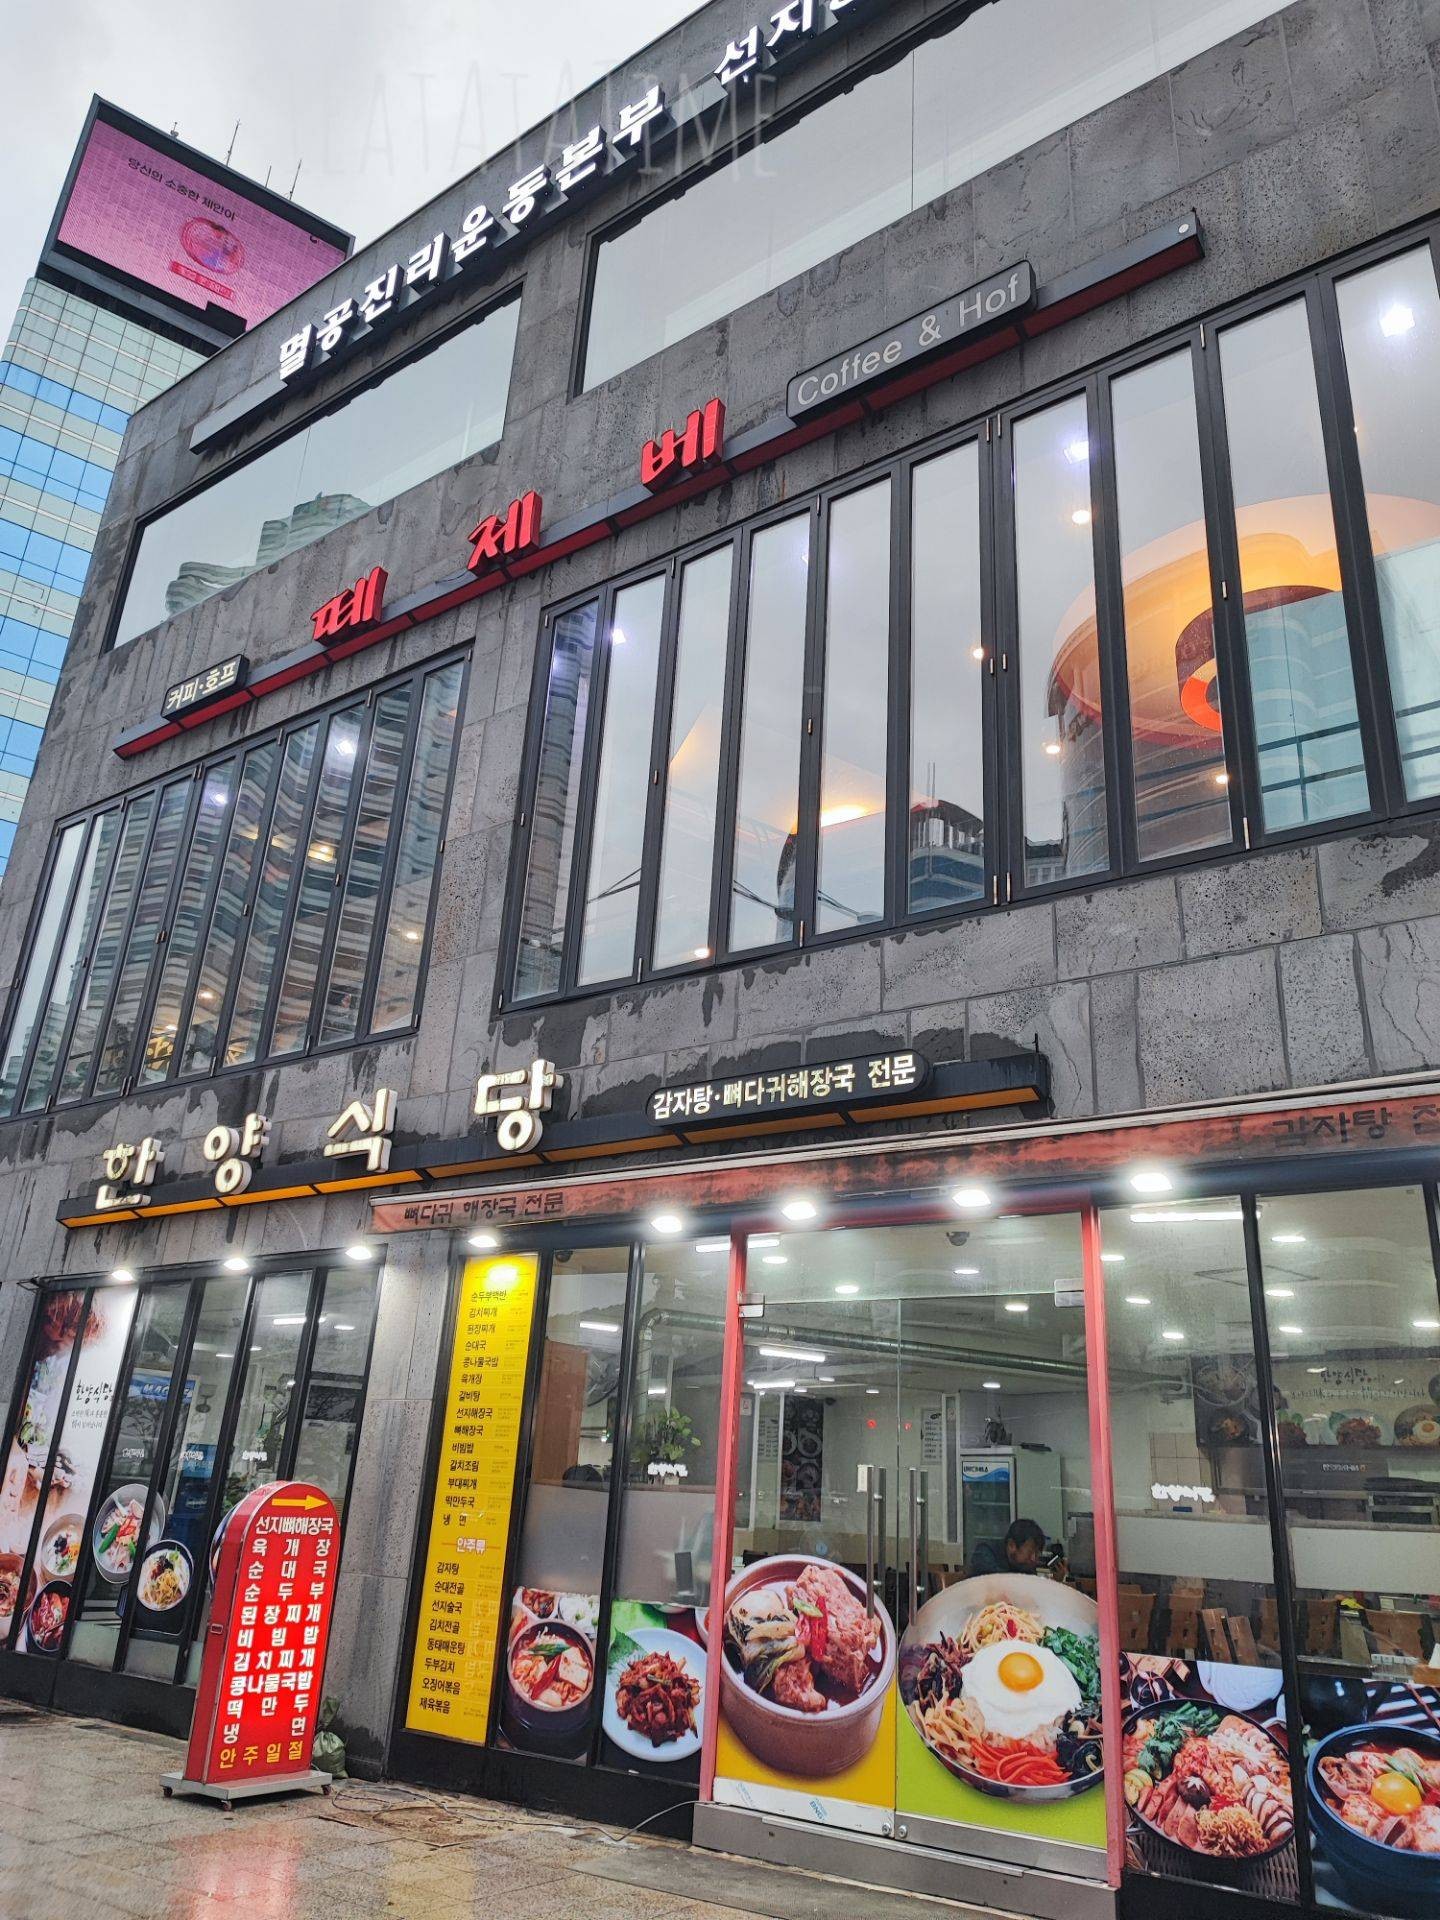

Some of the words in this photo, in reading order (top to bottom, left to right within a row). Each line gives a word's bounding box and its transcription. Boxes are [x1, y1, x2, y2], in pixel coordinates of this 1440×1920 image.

[278, 84, 666, 381] 멸공진리운동본부
[713, 0, 854, 87] 선지
[796, 340, 901, 406] Coffee
[918, 314, 943, 347] &
[959, 272, 1020, 327] Hof
[868, 1054, 917, 1088] 전문
[96, 1059, 562, 1210] 한양식당
[404, 1203, 454, 1226] 뼈다귀
[463, 1198, 517, 1221] 해장국
[524, 1191, 565, 1217] 전문
[465, 1340, 487, 1352] 순대국
[463, 1356, 499, 1368] 콩나물국밥
[461, 1373, 483, 1385] 육개장
[458, 1390, 481, 1402] 갈비탕
[456, 1407, 493, 1419] 선지해장국
[451, 1442, 474, 1454] 비빔밥
[450, 1459, 480, 1473] 갈치조림
[447, 1477, 478, 1490] 부대찌개
[445, 1495, 475, 1508] 떡만두국
[255, 1516, 334, 1535] 선지뼈해장국
[456, 1536, 486, 1556] 안주류
[437, 1561, 460, 1575] 감자탕
[434, 1580, 465, 1596] 순대전골
[431, 1600, 462, 1615] 선지술국
[429, 1618, 460, 1635] 김치전골
[427, 1637, 466, 1655] 동태매운탕
[424, 1657, 455, 1674] 두부김치
[230, 1670, 313, 1697] 콩나물국밥
[422, 1677, 461, 1696] 오징어볶음
[419, 1697, 451, 1715] 제육볶음
